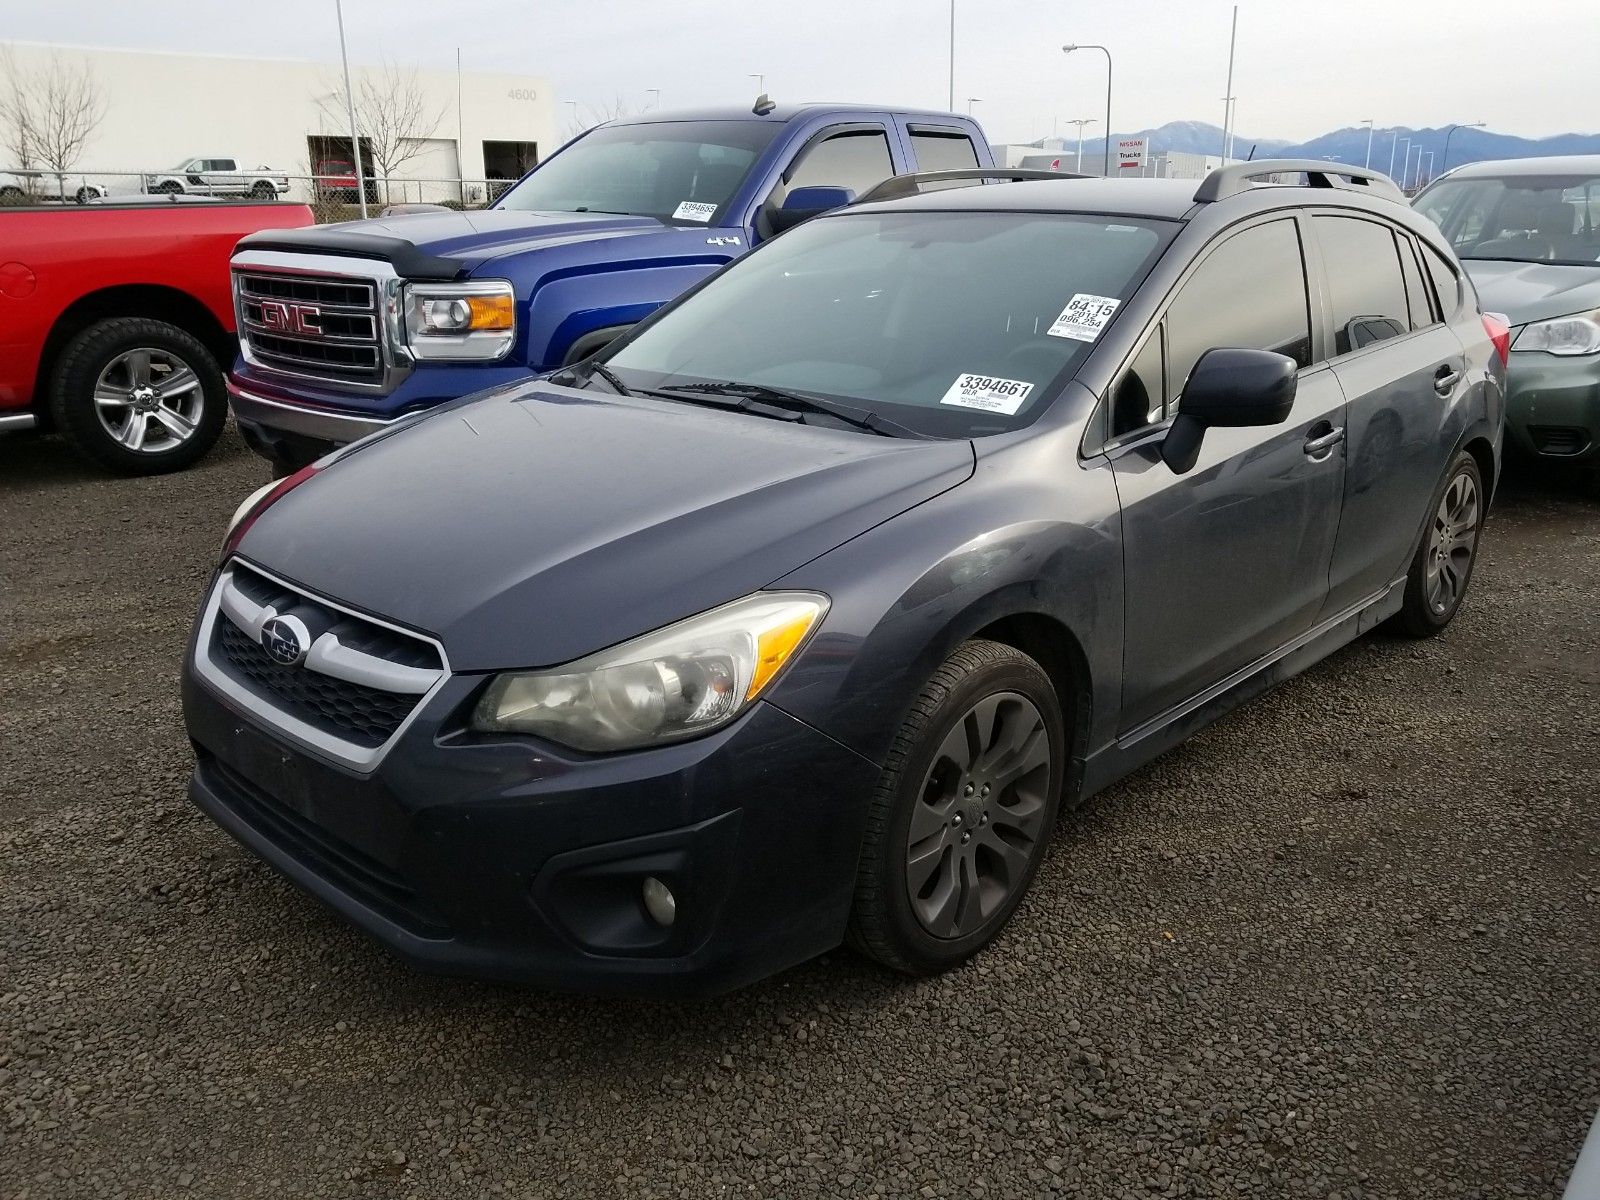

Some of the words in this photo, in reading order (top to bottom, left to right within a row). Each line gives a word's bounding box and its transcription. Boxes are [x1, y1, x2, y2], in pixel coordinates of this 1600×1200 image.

[508, 88, 537, 101] 4600
[1119, 140, 1143, 148] NISSAN
[681, 202, 716, 213] 3394655
[261, 300, 323, 335] GMC
[1072, 310, 1099, 319] 2012
[959, 375, 1030, 398] 3394661
[961, 388, 978, 396] DLR
